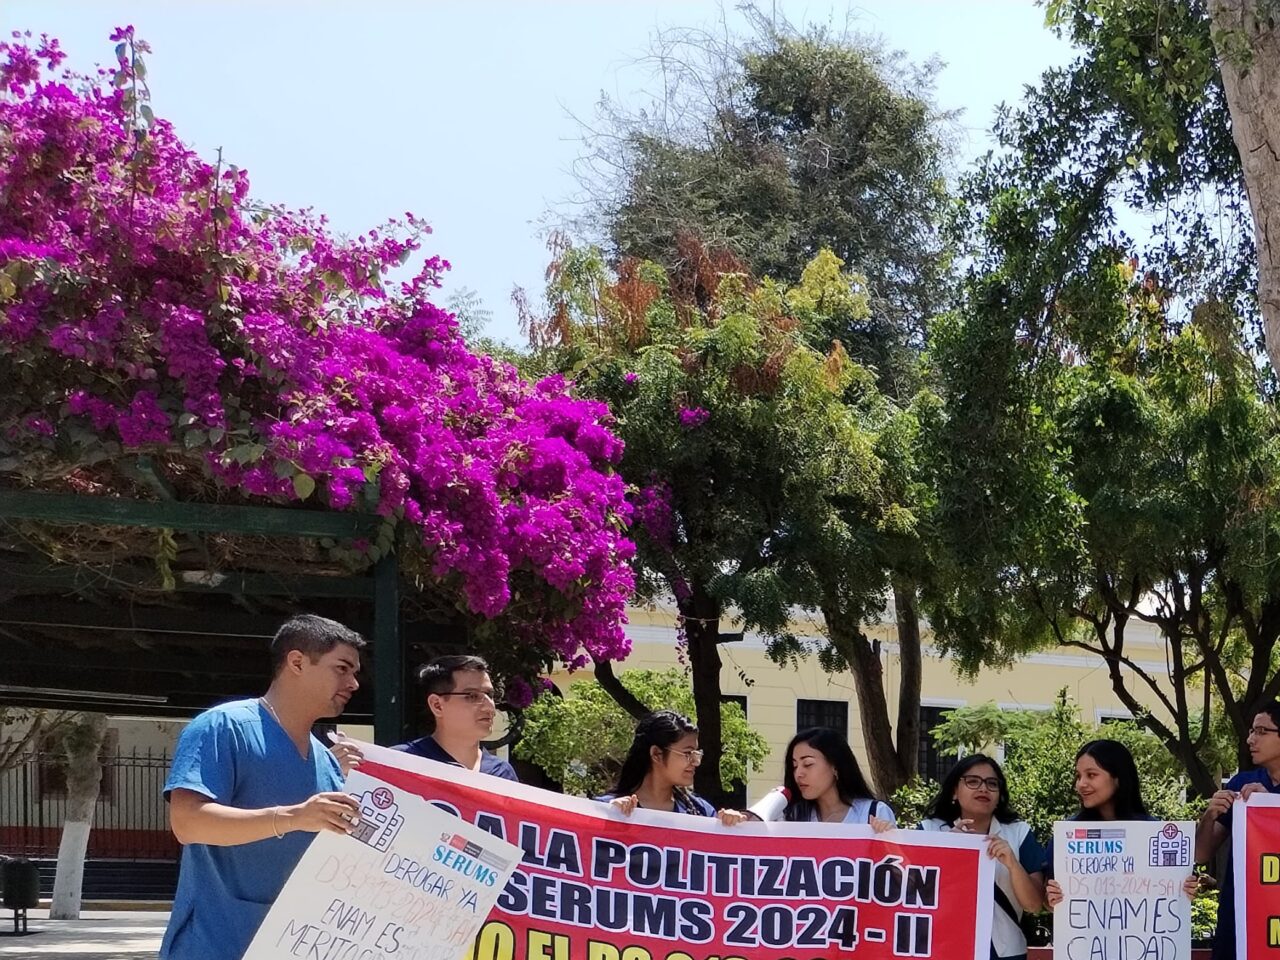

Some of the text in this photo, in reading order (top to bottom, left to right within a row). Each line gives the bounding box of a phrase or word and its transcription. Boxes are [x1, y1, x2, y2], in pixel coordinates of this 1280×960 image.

[432, 844, 499, 888] SERUMS
[518, 821, 583, 876] LA
[592, 837, 939, 909] POLITIZACIÓN
[1067, 841, 1123, 854] SERUMS
[1121, 856, 1135, 873] YA
[321, 898, 404, 953] ENAM ES
[497, 871, 714, 943] SERUMS
[724, 902, 857, 950] 2024
[894, 913, 932, 957] II
[1069, 897, 1181, 934] ENAM ES
